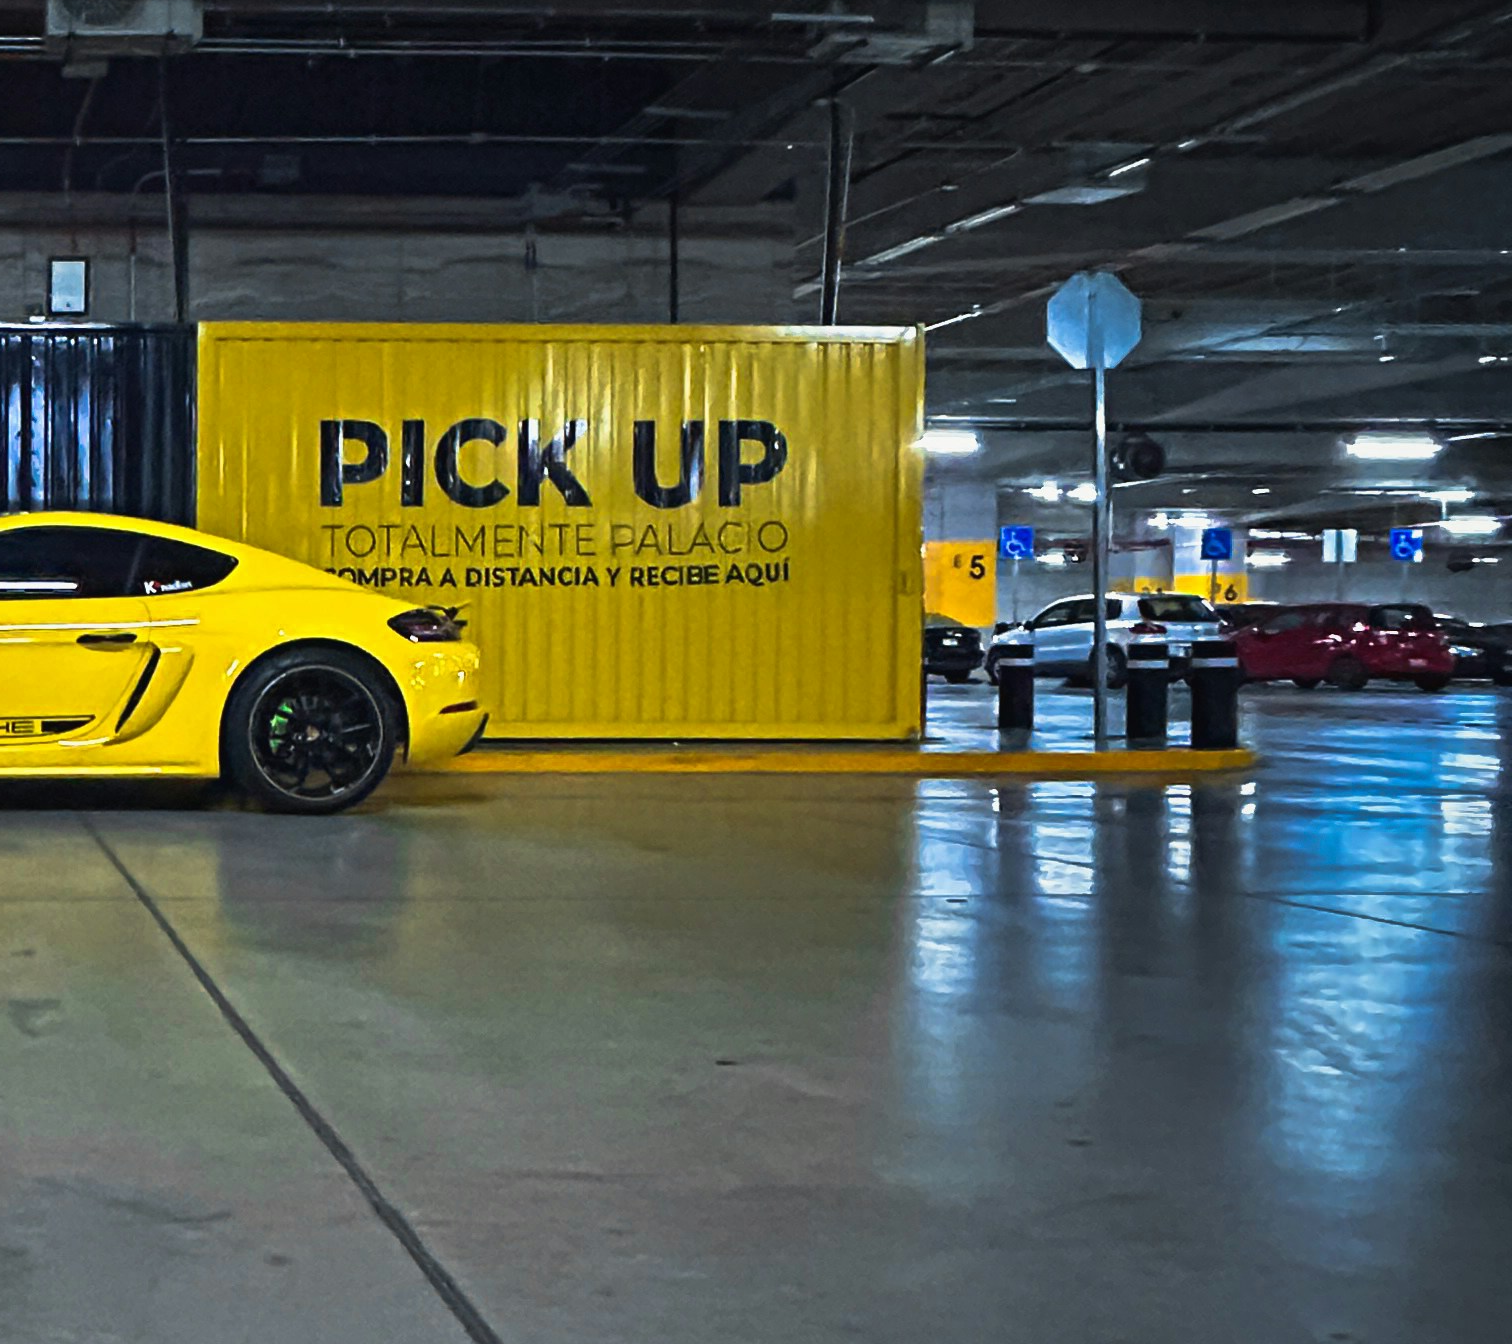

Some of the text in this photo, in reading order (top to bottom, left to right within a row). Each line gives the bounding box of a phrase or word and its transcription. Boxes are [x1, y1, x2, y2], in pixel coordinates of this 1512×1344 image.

[320, 418, 788, 509] PICK UP
[321, 520, 788, 558] TOTALMENTE PALACIO
[439, 567, 457, 588] A
[465, 566, 599, 588] DISTANCIA
[605, 567, 621, 587] Y
[630, 565, 720, 586] RECIBE
[724, 557, 791, 586] AQUÍ
[970, 554, 986, 580] 5
[1224, 583, 1238, 601] 6
